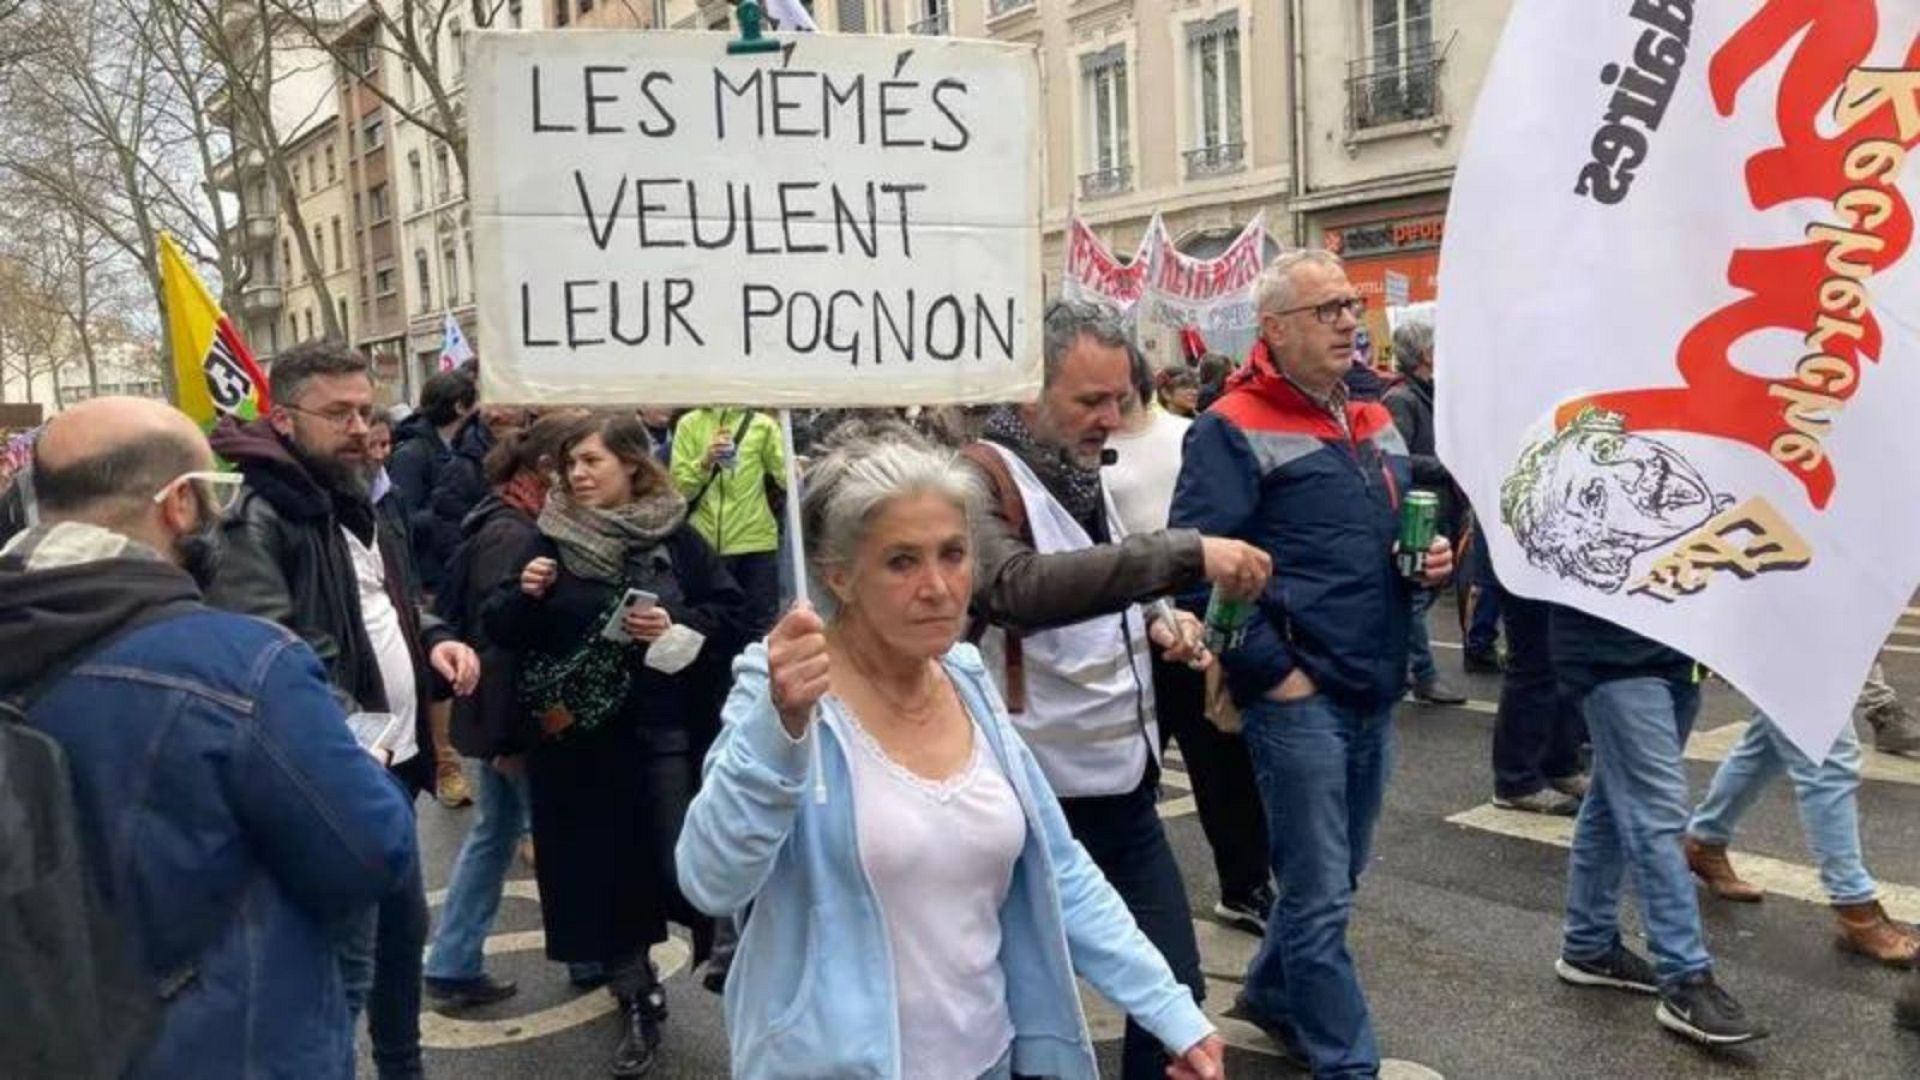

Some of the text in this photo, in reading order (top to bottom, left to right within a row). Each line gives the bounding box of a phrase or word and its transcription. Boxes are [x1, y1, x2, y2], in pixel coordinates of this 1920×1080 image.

[531, 42, 971, 152] LES MÉMÉS
[573, 169, 927, 258] VEULENT
[521, 278, 1015, 366] LEUR POGNON
